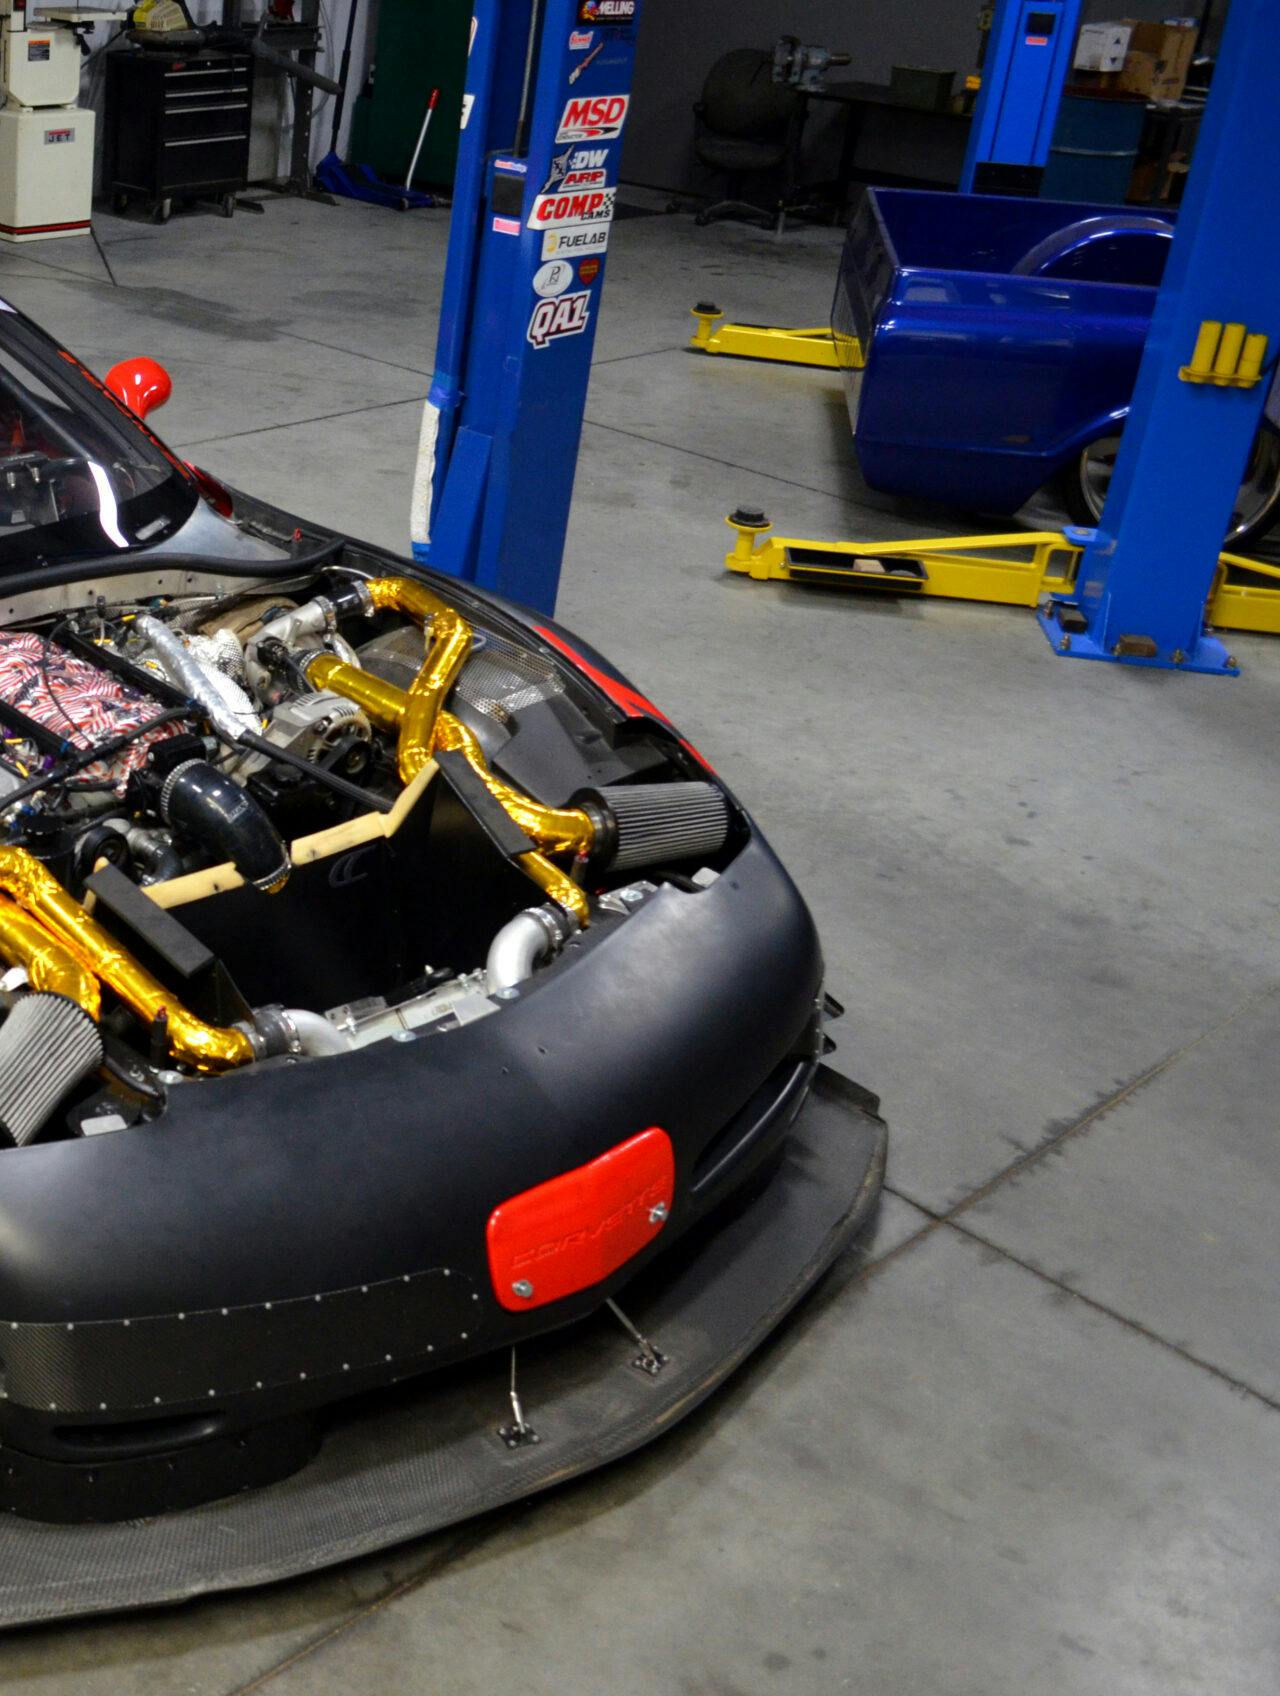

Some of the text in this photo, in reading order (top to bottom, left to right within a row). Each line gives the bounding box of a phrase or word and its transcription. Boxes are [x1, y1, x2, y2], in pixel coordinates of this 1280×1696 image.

[563, 97, 626, 128] MSD
[48, 133, 71, 143] JET
[564, 171, 604, 184] ARP
[536, 193, 604, 221] COMP
[581, 209, 611, 220] CAMS
[558, 231, 607, 249] FUELAB
[529, 293, 589, 347] QA1
